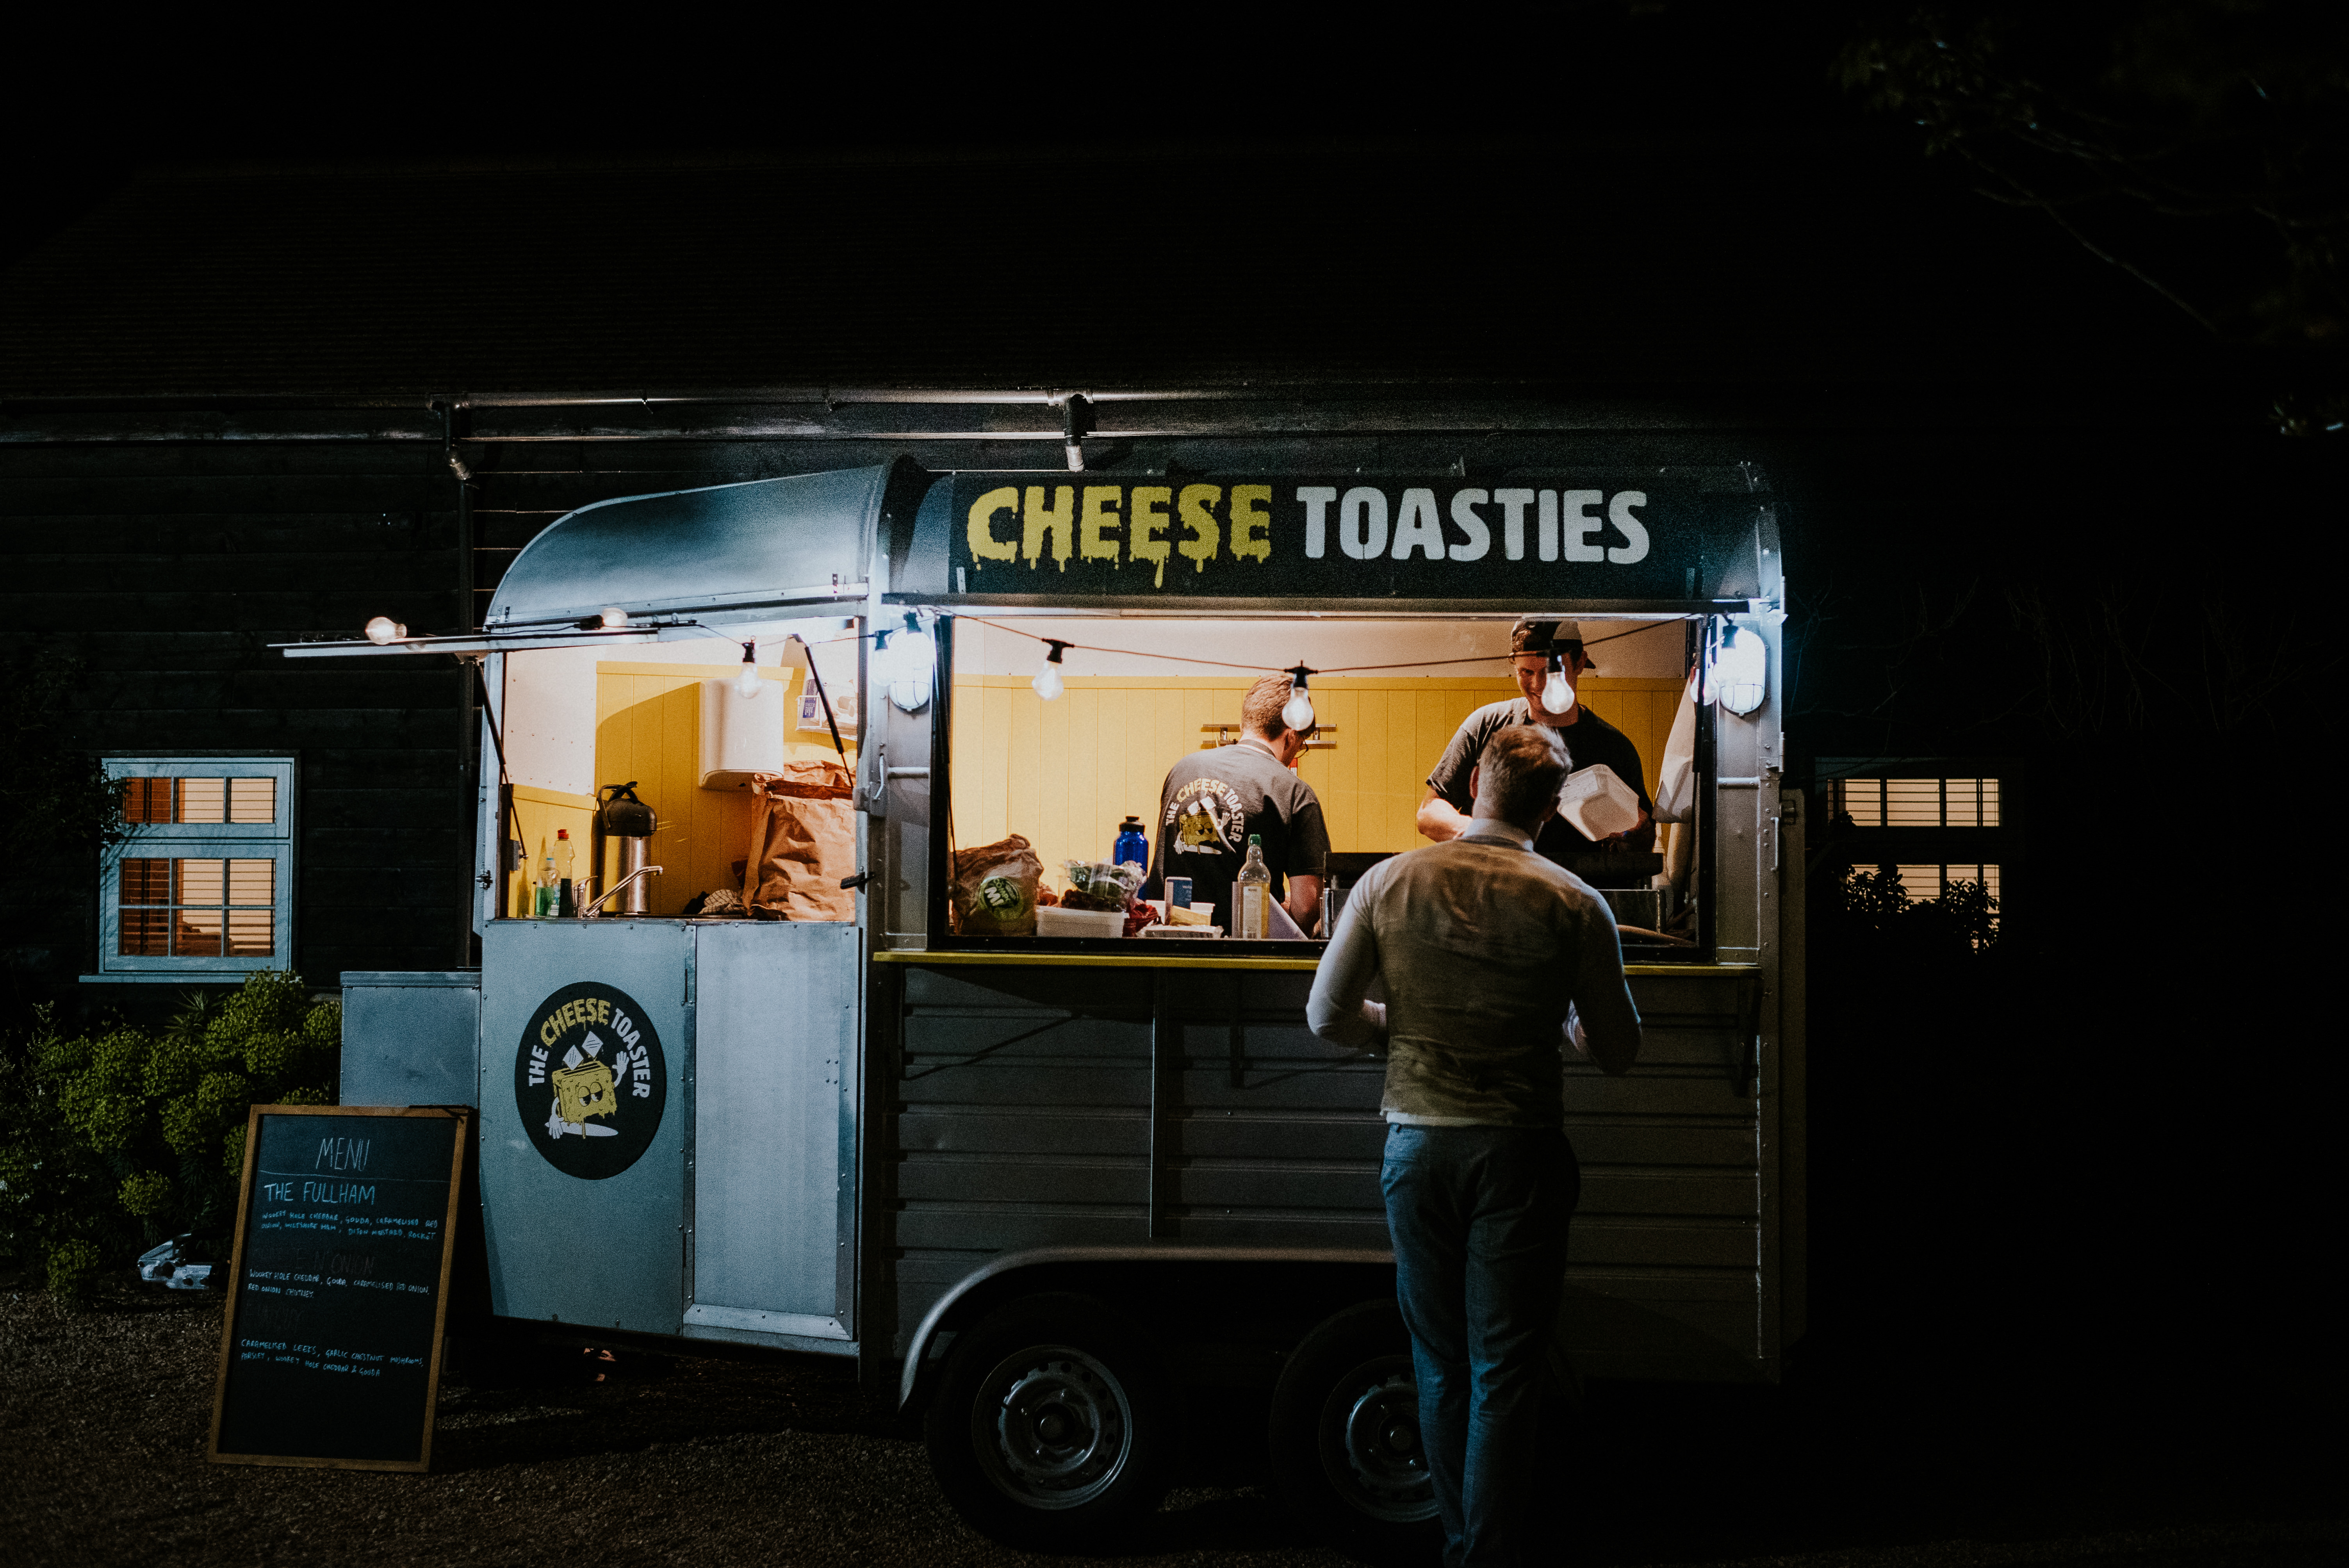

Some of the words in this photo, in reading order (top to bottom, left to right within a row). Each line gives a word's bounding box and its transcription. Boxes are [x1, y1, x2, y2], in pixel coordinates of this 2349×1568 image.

[967, 483, 1272, 588] CHEESE
[1296, 486, 1650, 565] TOASTIES
[1166, 802, 1180, 826] THE
[1176, 778, 1228, 802] CHEESE
[1224, 789, 1244, 842] TOASTER
[529, 1045, 549, 1087] THE
[541, 998, 611, 1048] CHEESE
[611, 1008, 651, 1098] TOASTER
[316, 1137, 370, 1171] MENU
[264, 1182, 293, 1201] THE
[304, 1182, 375, 1205] FULLHAM
[345, 1216, 372, 1226] GOUDA,
[425, 1219, 438, 1228] RED
[408, 1231, 436, 1240] ROCKET
[248, 1283, 259, 1291] RED
[396, 1282, 406, 1291] RED
[326, 1349, 348, 1358] GARLIC
[351, 1353, 385, 1361] CHESTNUT
[276, 1356, 300, 1364] WOOKEY
[305, 1360, 320, 1368] HOLE
[323, 1364, 349, 1372] CHEDDAR
[359, 1368, 380, 1376] GOUDA
